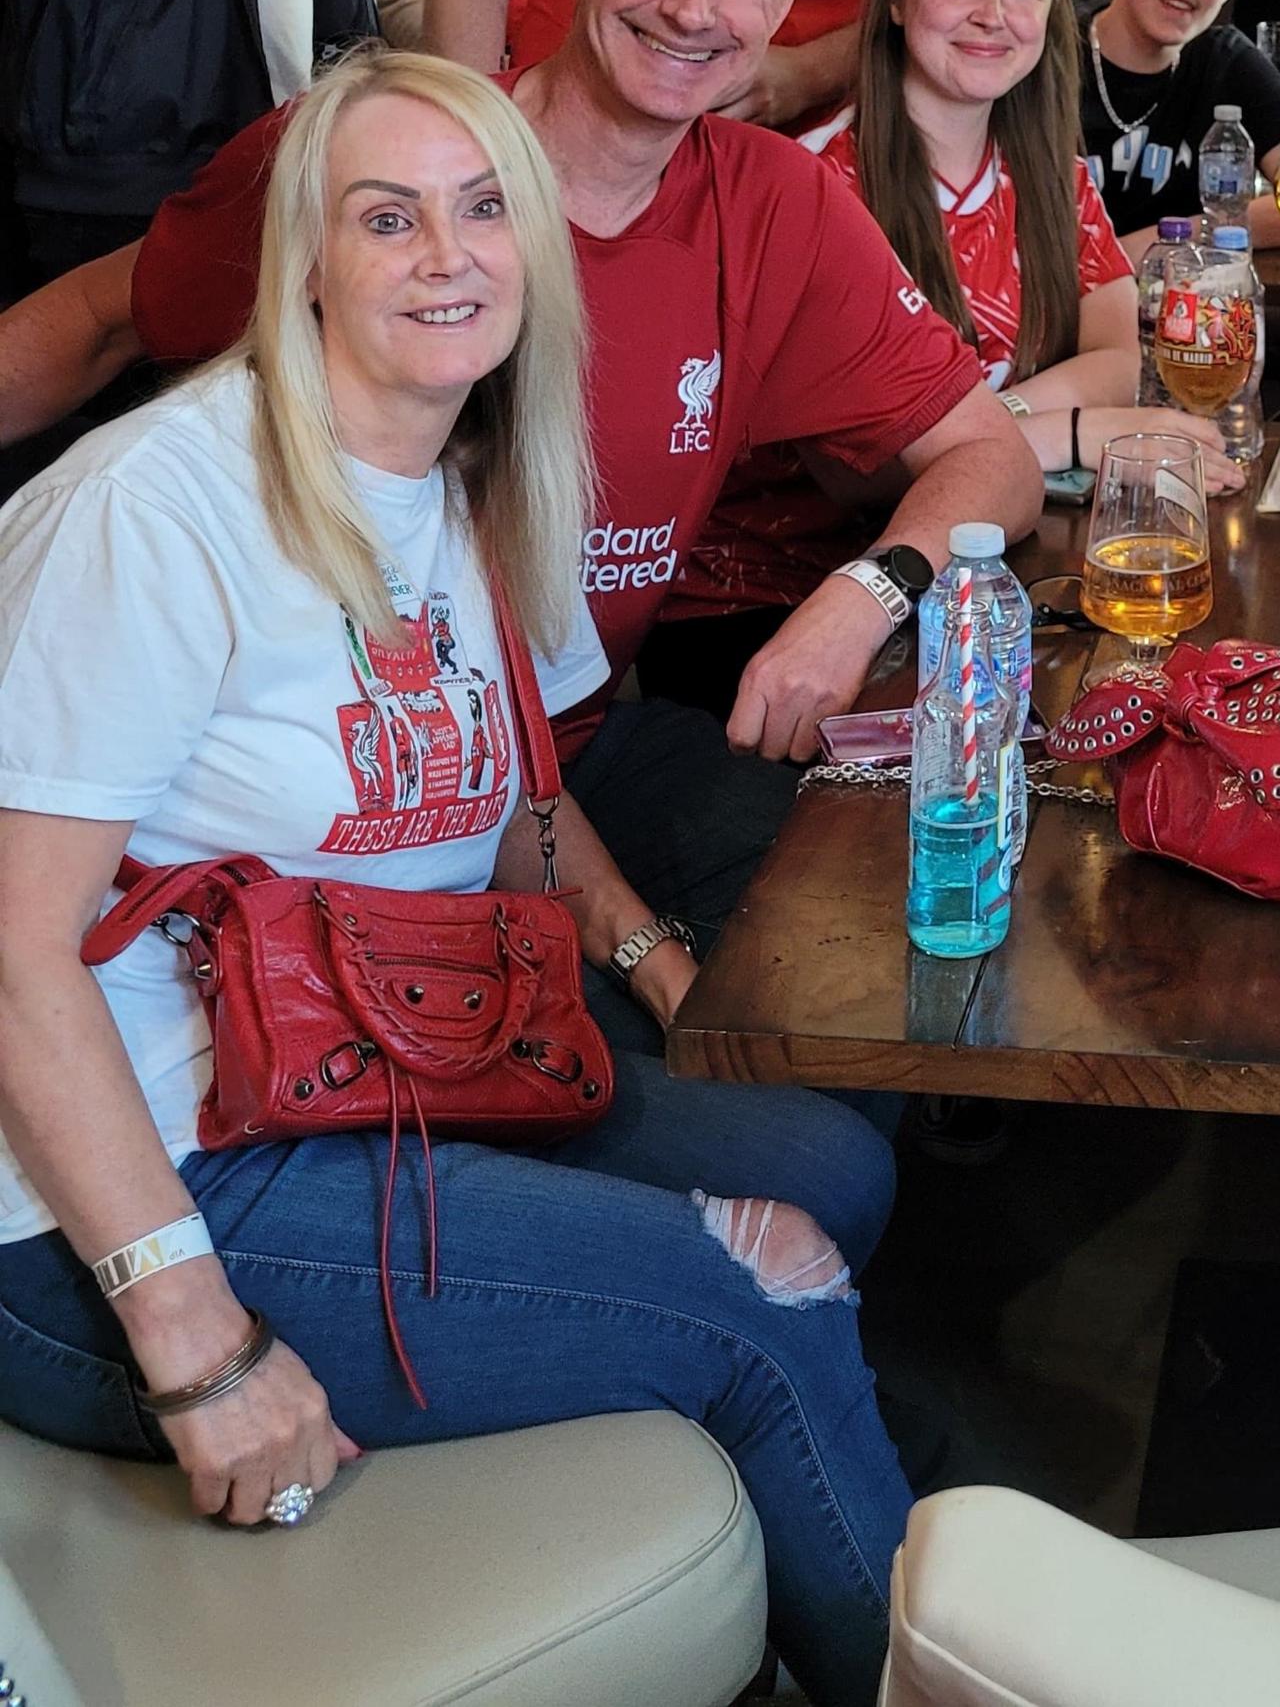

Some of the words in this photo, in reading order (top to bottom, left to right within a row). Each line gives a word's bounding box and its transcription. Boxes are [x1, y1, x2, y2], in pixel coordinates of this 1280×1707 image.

[330, 815, 403, 852] THESE
[399, 808, 438, 845] ARE
[437, 802, 473, 839] THE
